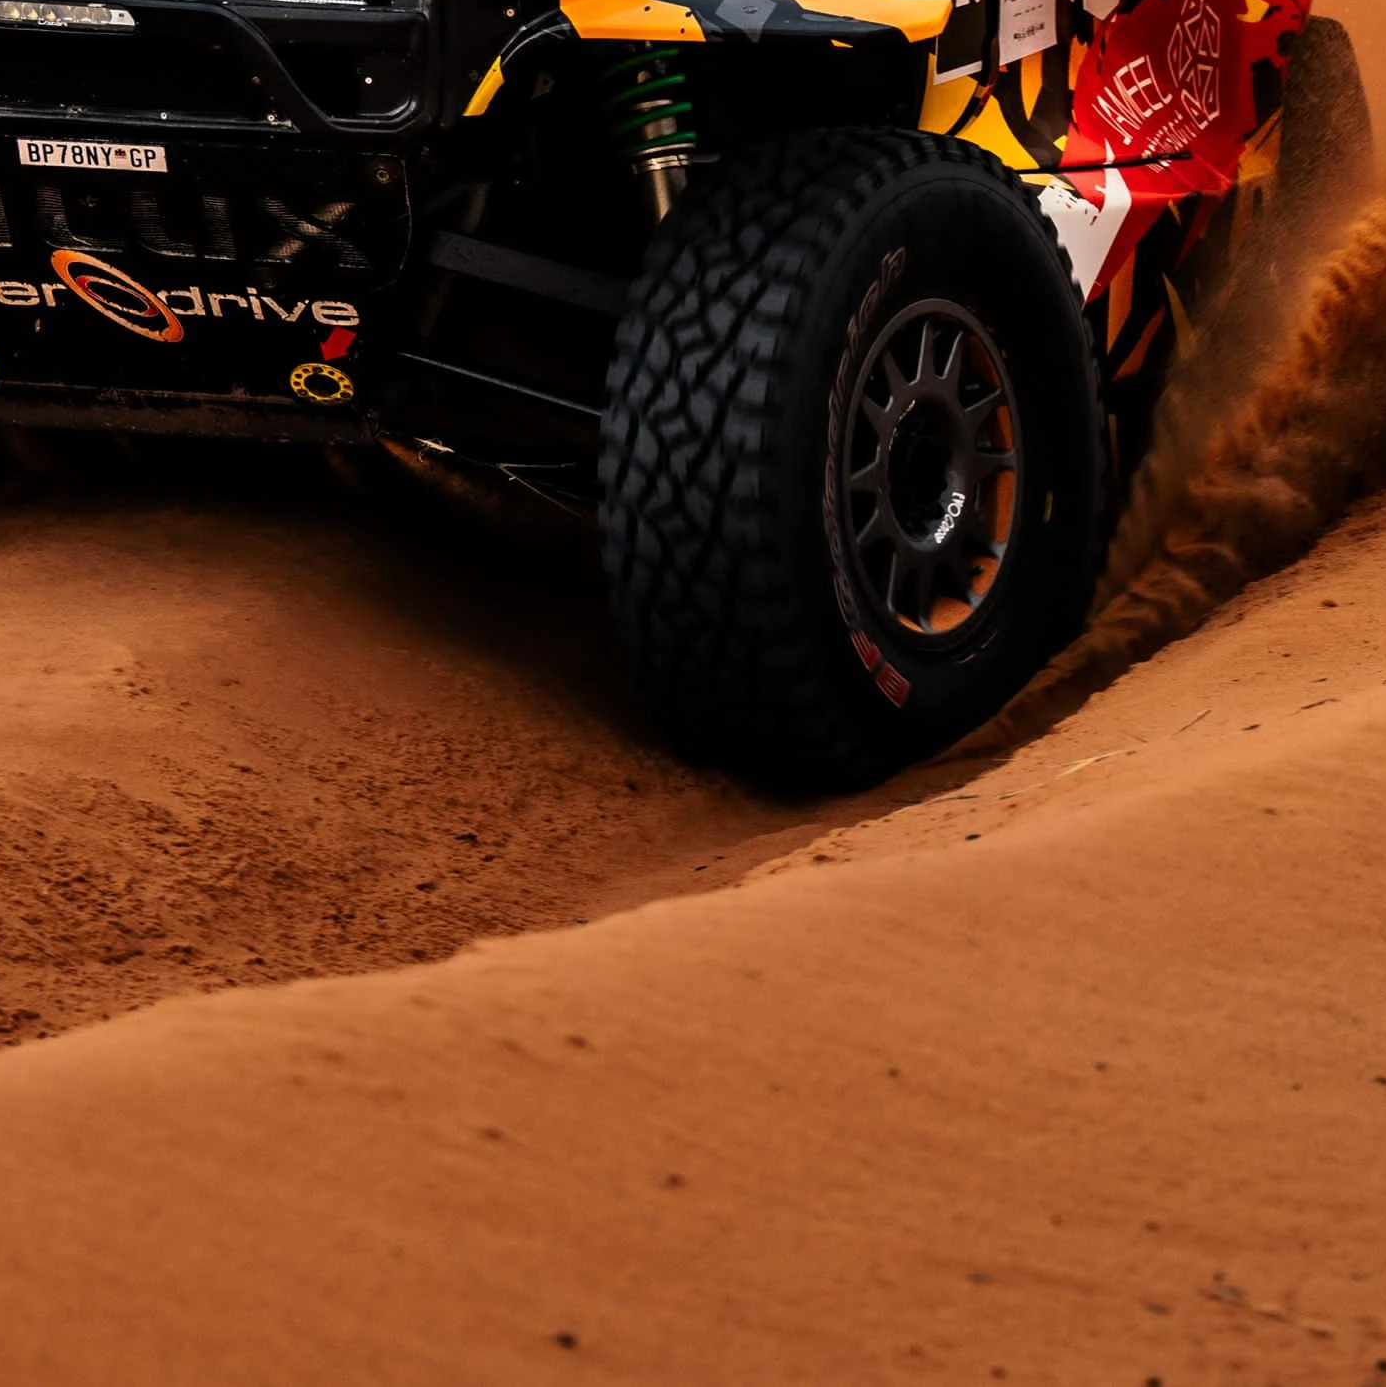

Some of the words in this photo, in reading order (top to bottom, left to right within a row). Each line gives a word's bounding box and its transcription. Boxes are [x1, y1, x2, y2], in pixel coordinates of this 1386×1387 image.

[1092, 54, 1173, 146] JAMEEL
[27, 143, 112, 166] BP78NY
[130, 148, 156, 168] GP
